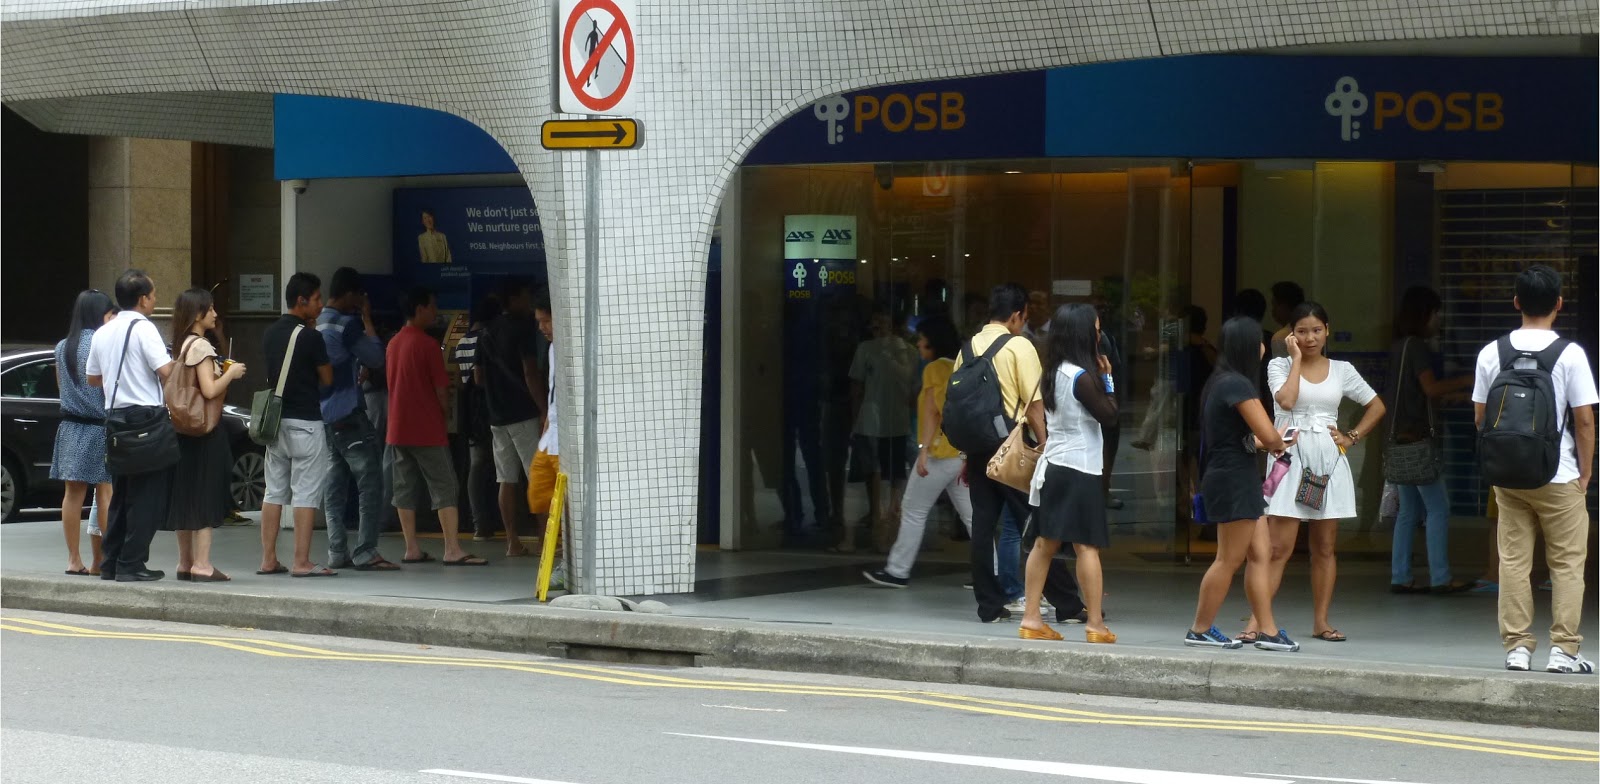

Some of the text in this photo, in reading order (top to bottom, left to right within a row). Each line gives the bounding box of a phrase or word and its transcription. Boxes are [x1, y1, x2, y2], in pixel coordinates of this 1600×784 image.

[854, 92, 966, 133] POSB
[1373, 91, 1505, 131] POSB
[466, 207, 482, 217] We
[483, 206, 508, 217] don't
[510, 206, 528, 220] just
[468, 222, 483, 232] We
[486, 223, 520, 232] nurture
[786, 231, 815, 239] AXS
[822, 229, 852, 240] AXS
[489, 242, 525, 251] Neighbours
[828, 271, 855, 285] POSB
[789, 290, 811, 298] POSB
